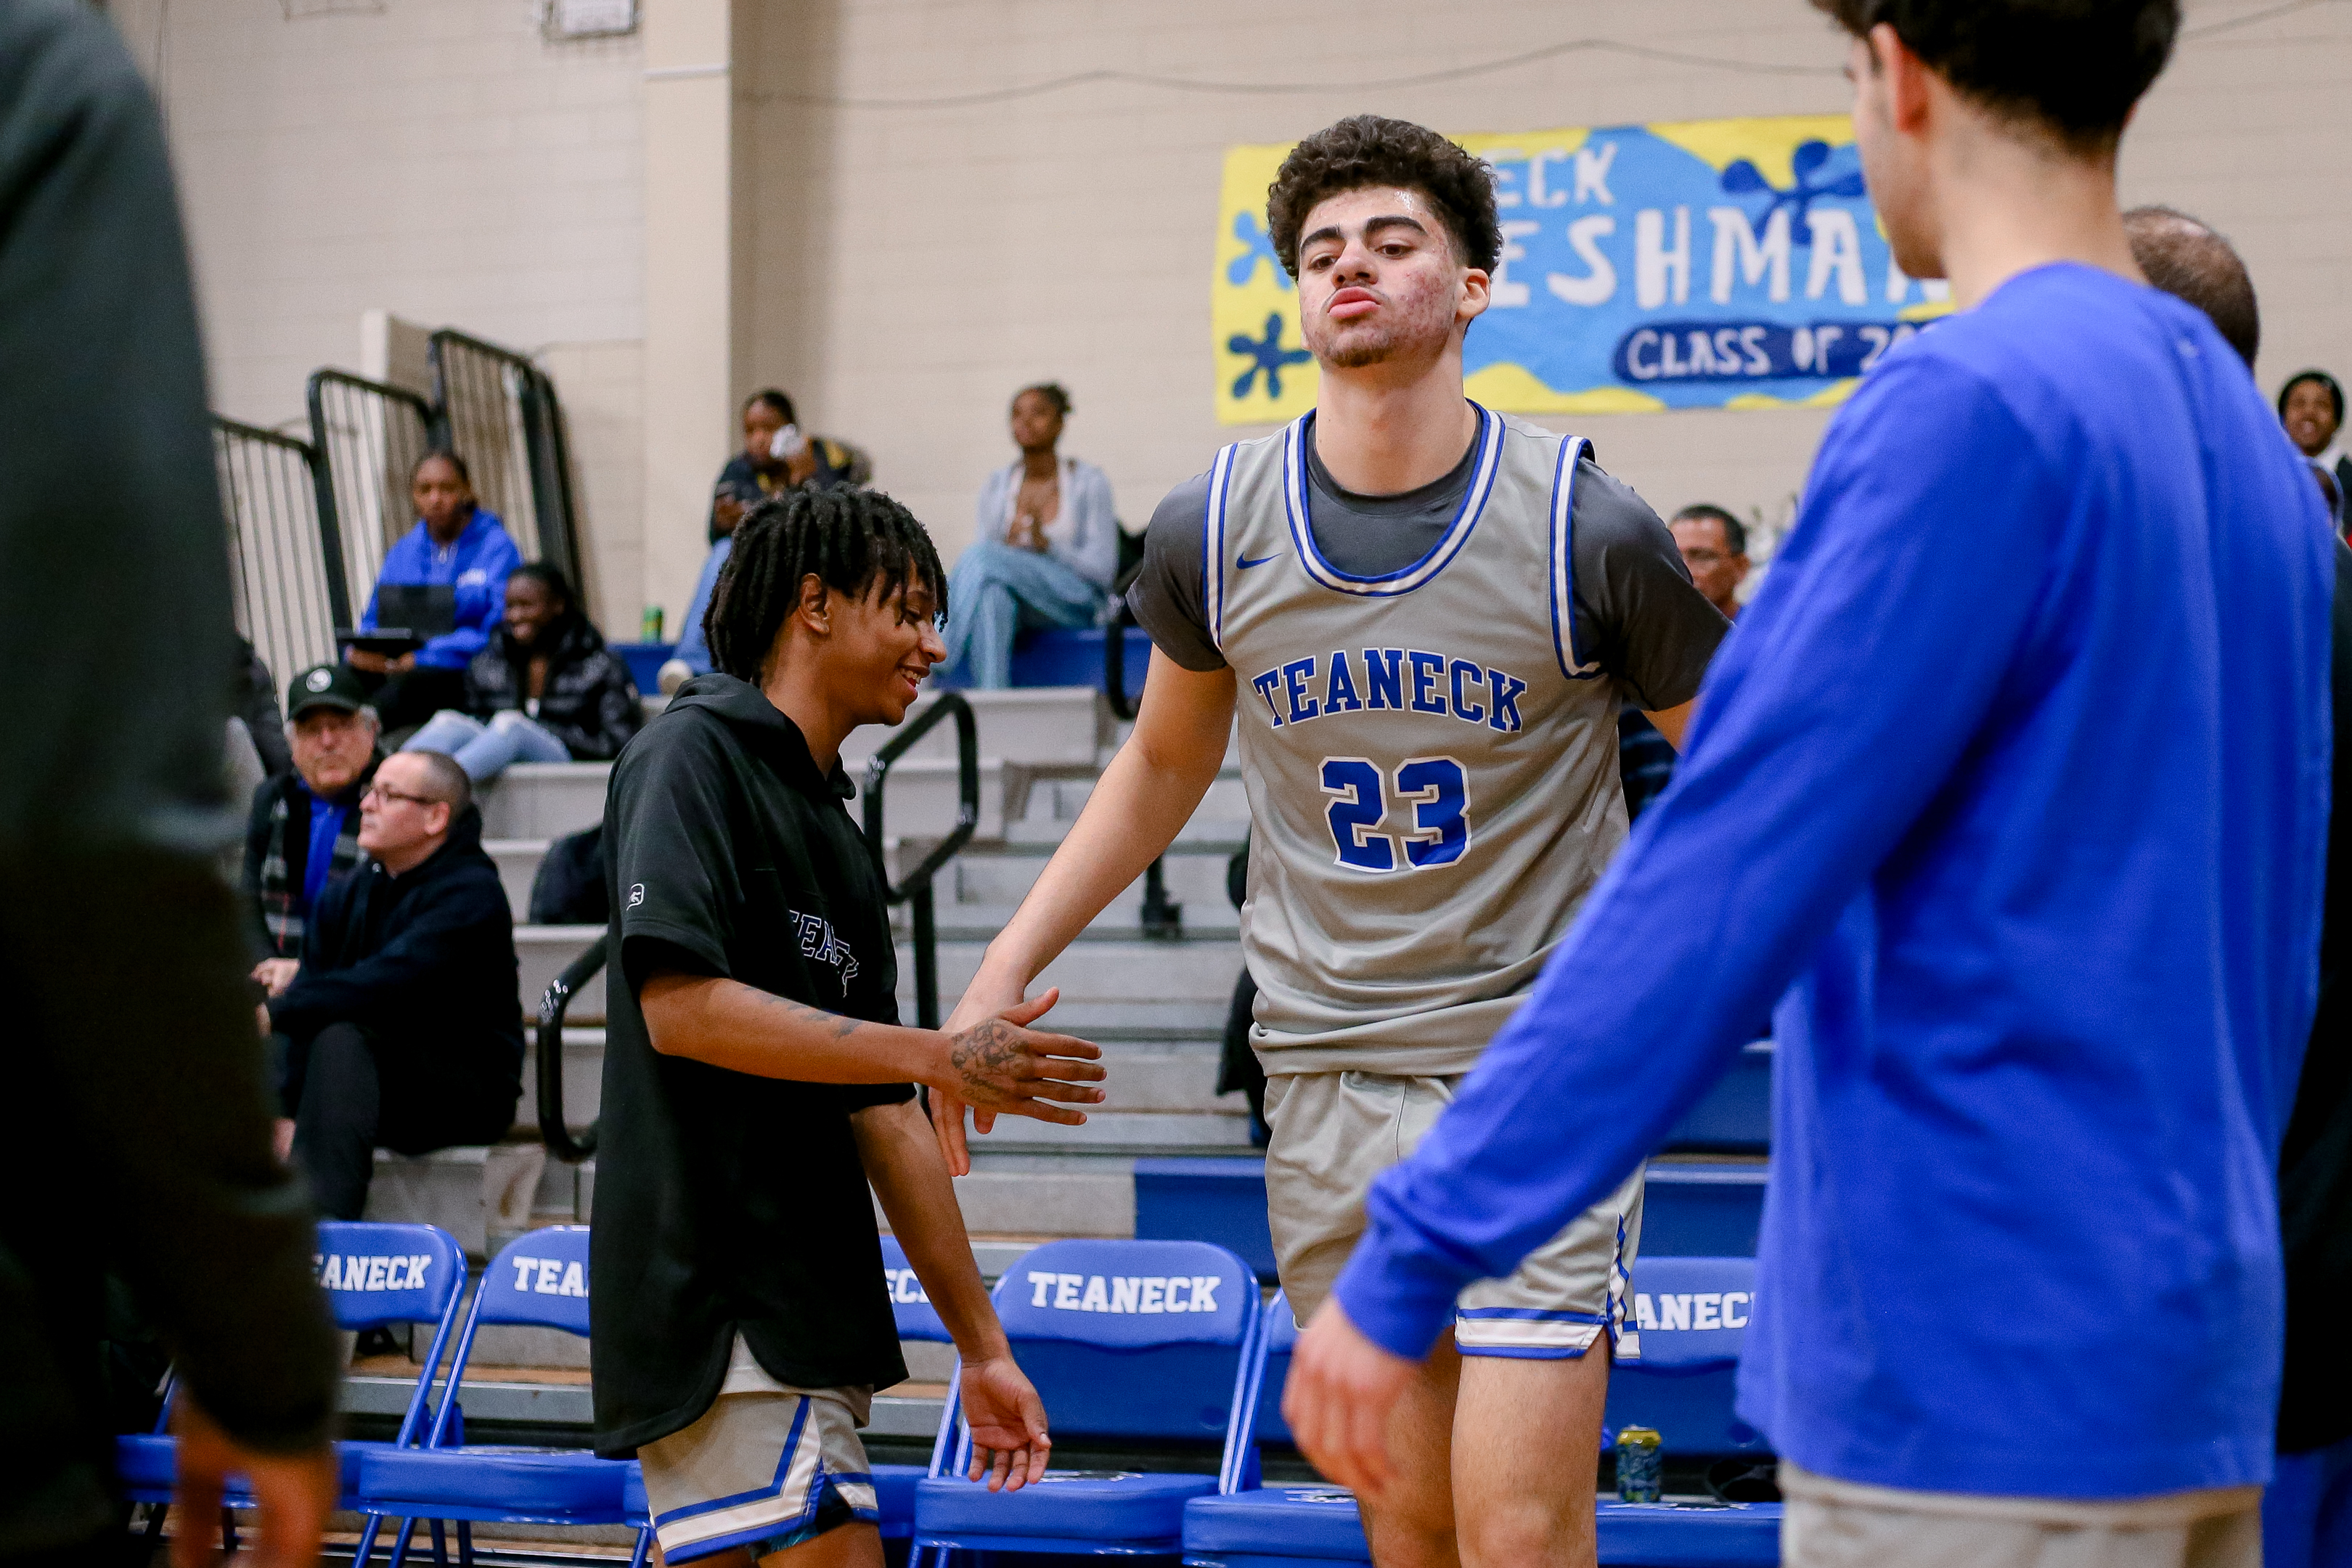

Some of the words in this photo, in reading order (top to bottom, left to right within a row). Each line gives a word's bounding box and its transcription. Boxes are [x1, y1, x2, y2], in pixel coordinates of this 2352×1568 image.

[1627, 329, 1770, 380] CLASS
[1251, 648, 1527, 733] TEANECK
[1318, 755, 1471, 873] 23
[313, 1254, 433, 1291] ANECK
[513, 1255, 589, 1297] TEA
[1028, 1271, 1221, 1314] TEANECK
[1634, 1291, 1755, 1331] ANEC
